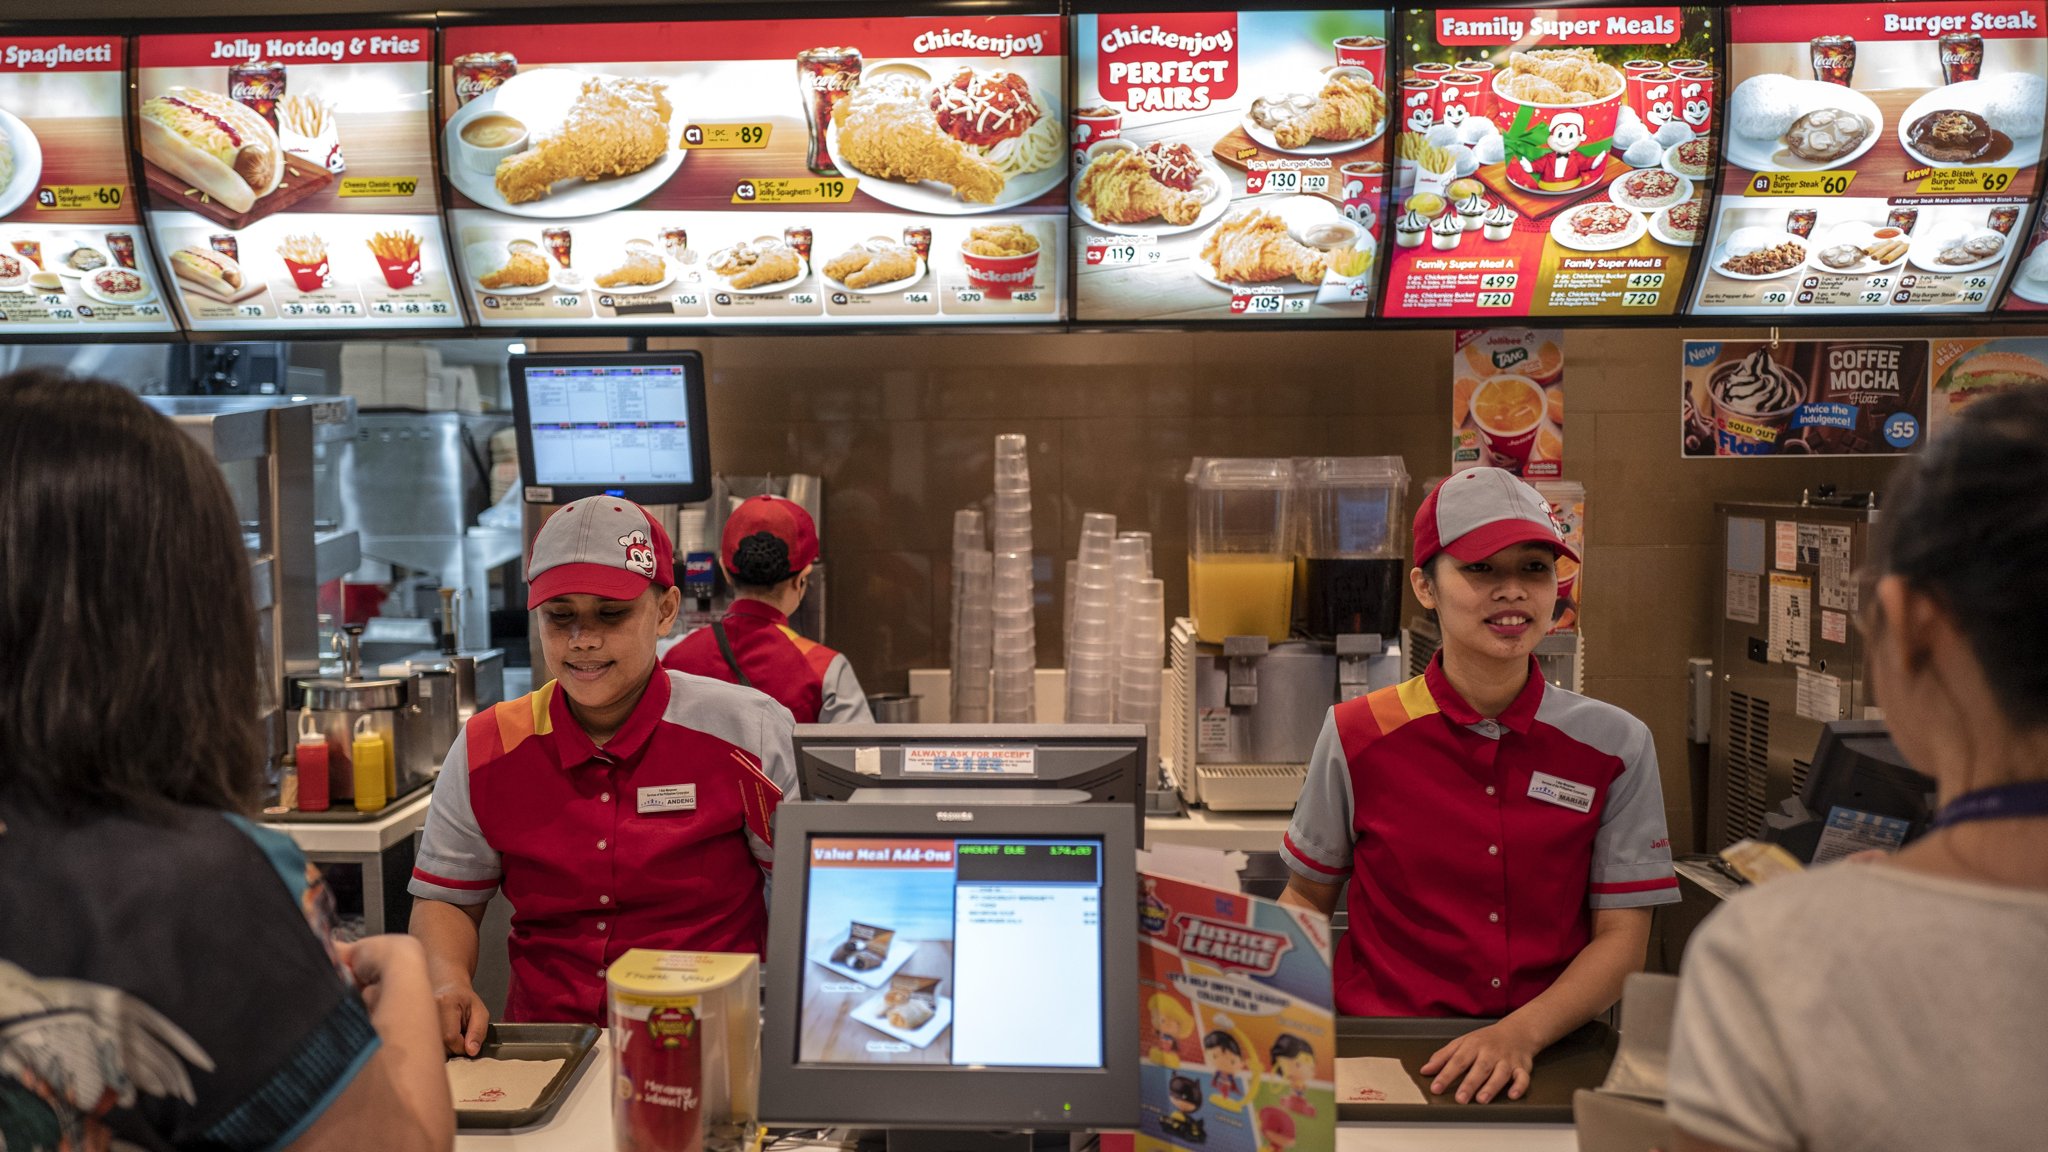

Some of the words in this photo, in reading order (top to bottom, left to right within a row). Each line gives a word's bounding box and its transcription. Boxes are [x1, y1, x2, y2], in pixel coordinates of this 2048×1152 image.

[1442, 16, 1523, 41] Family
[1529, 18, 1600, 41] Super
[1605, 15, 1675, 36] Meals
[1883, 13, 1966, 37] Burger
[1971, 11, 2038, 31] Steak
[913, 29, 1044, 58] Chickenjoy
[1101, 25, 1233, 56] Chickenjoy
[5, 44, 111, 68] Spaghetti
[211, 39, 261, 61] Jolly
[266, 37, 345, 61] Hotdog
[349, 38, 367, 55] &
[370, 36, 420, 54] Fries
[1109, 60, 1229, 84] PERFECT
[1127, 86, 1209, 111] PAIRS
[686, 128, 701, 142] C1
[1906, 168, 1931, 181] New
[1931, 178, 1957, 186] Burger
[1247, 178, 1262, 187] C4
[1756, 180, 1767, 189] B1
[1773, 181, 1798, 190] Burger
[736, 184, 754, 197] C3
[1416, 260, 1447, 270] Family
[1449, 260, 1478, 270] Super
[1479, 259, 1505, 269] Meal
[1506, 259, 1514, 268] A
[1564, 259, 1596, 269] Family
[1597, 259, 1627, 269] Super
[1628, 259, 1652, 268] Meal
[1654, 259, 1661, 267] B
[1497, 350, 1524, 367] TANG
[1688, 345, 1716, 361] New
[1829, 350, 1900, 371] COFFEE
[1830, 370, 1900, 391] MOCHA
[1849, 392, 1879, 406] Float
[1803, 405, 1829, 415] Twice
[1832, 406, 1848, 415] the
[1800, 414, 1850, 427] indulgence!
[1728, 421, 1752, 434] SOLD
[1756, 429, 1776, 440] OUT
[1719, 430, 1773, 455] Flo
[911, 750, 947, 758] ALWAYS
[950, 750, 968, 758] ASK
[1559, 794, 1589, 807] MARIAN
[1650, 838, 1670, 849] Jolli
[814, 847, 854, 861] Value
[857, 848, 889, 861] Meal
[892, 849, 951, 862] Add-Ons
[1187, 919, 1278, 950] JUSTICE
[1183, 934, 1272, 969] LEAGUE
